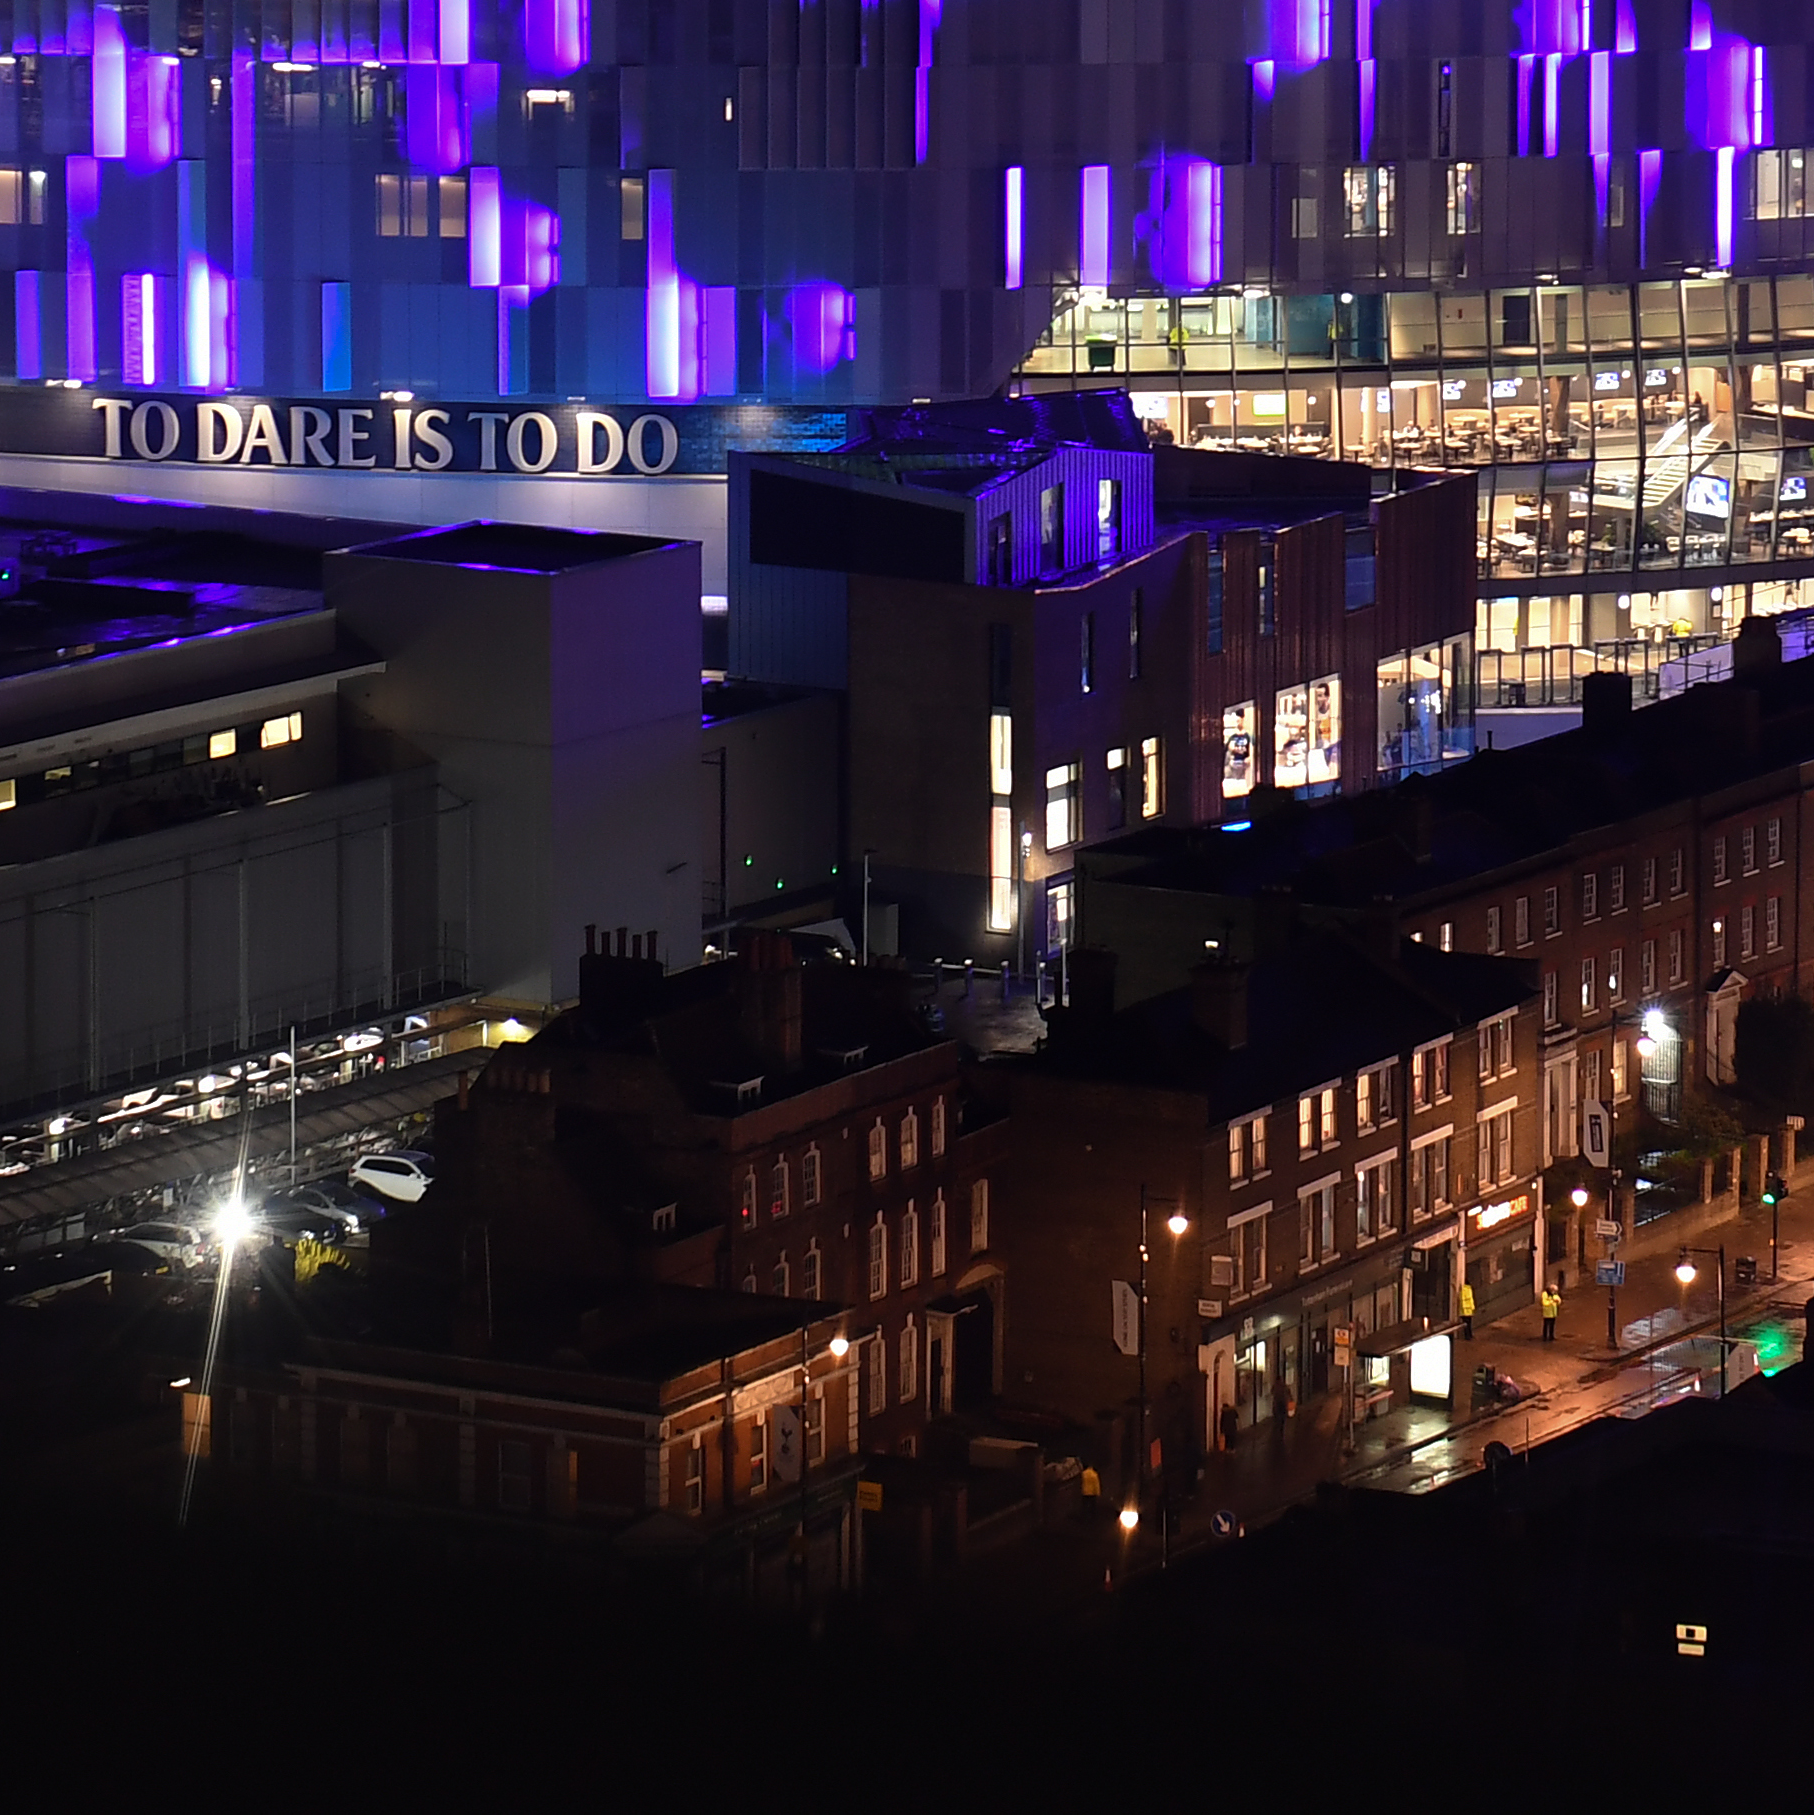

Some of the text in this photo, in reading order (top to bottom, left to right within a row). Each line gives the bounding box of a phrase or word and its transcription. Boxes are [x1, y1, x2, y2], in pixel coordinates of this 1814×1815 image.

[92, 397, 679, 476] TO DARE IS TO DO
